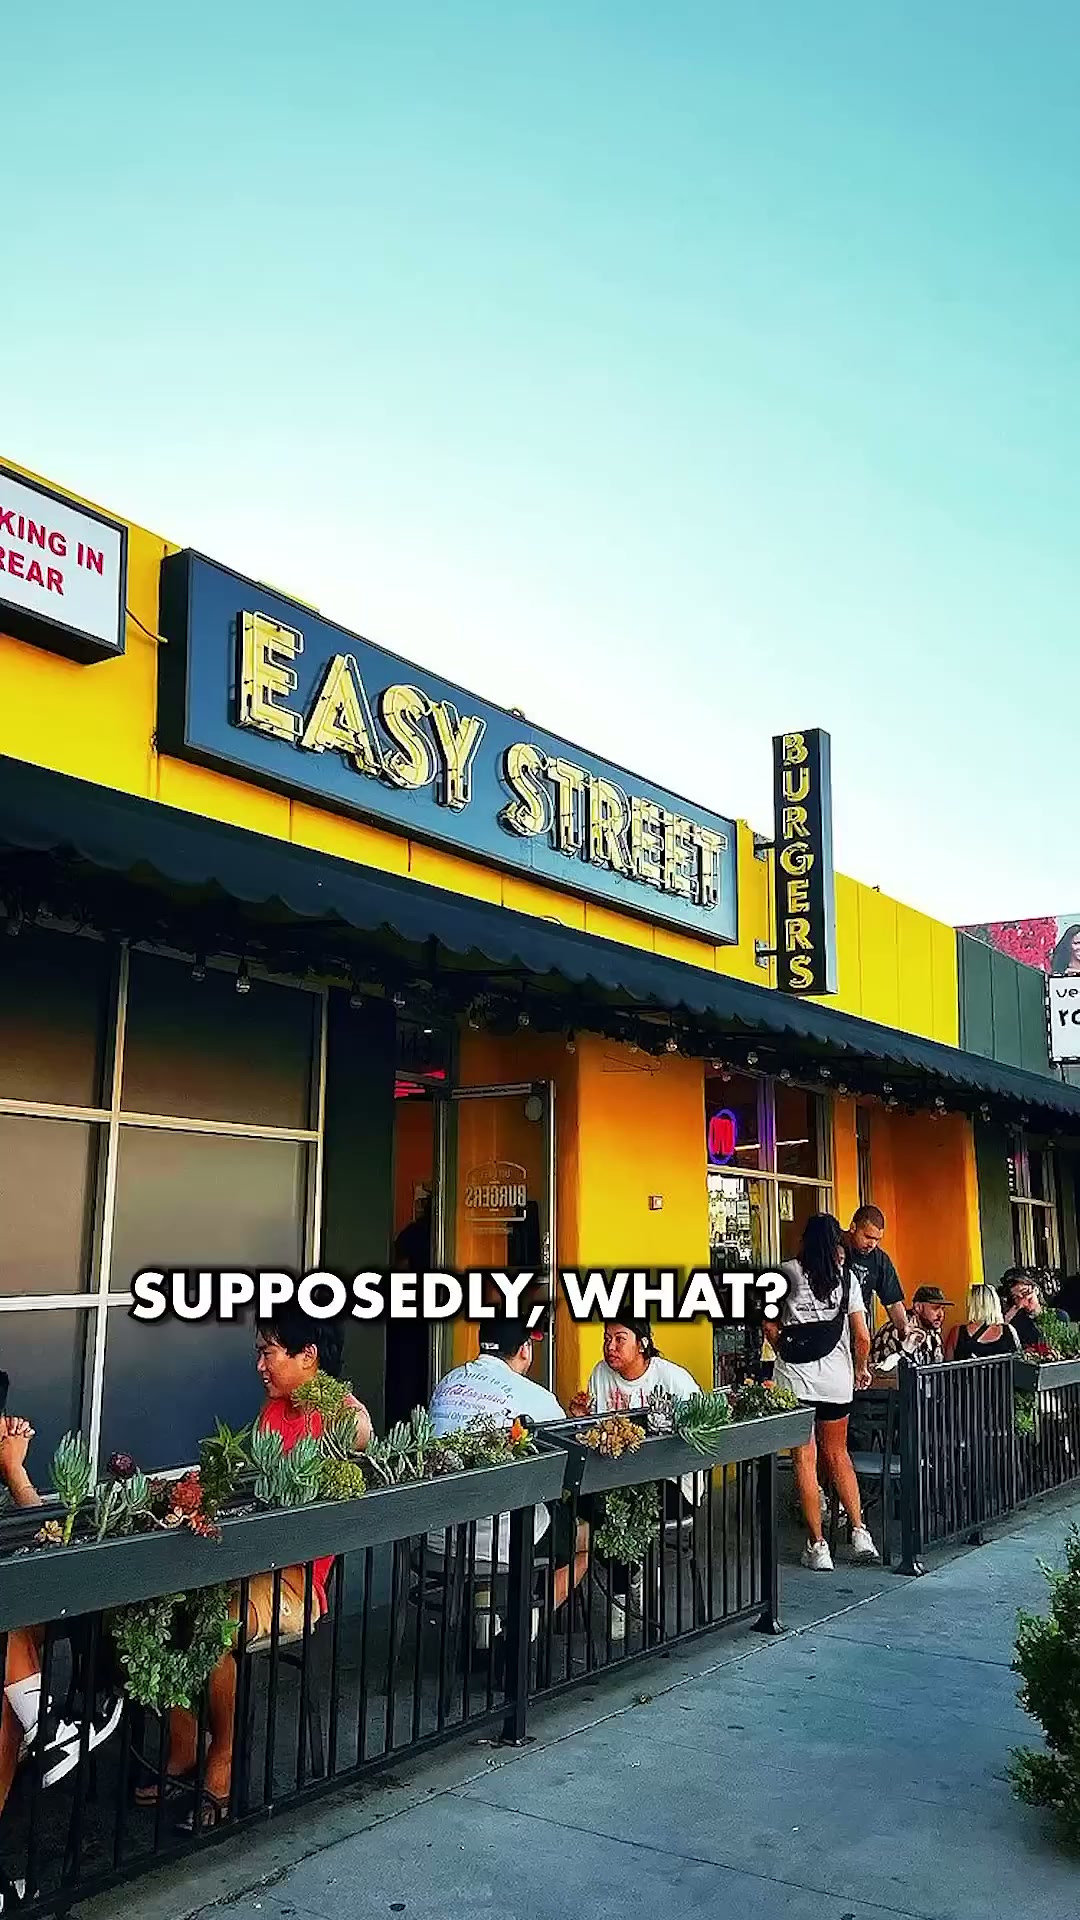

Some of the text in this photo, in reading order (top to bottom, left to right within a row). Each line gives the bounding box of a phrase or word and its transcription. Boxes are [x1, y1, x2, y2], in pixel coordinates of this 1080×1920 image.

[78, 542, 104, 576] IN
[238, 610, 728, 911] EASY STREET
[780, 733, 815, 989] BURGERS
